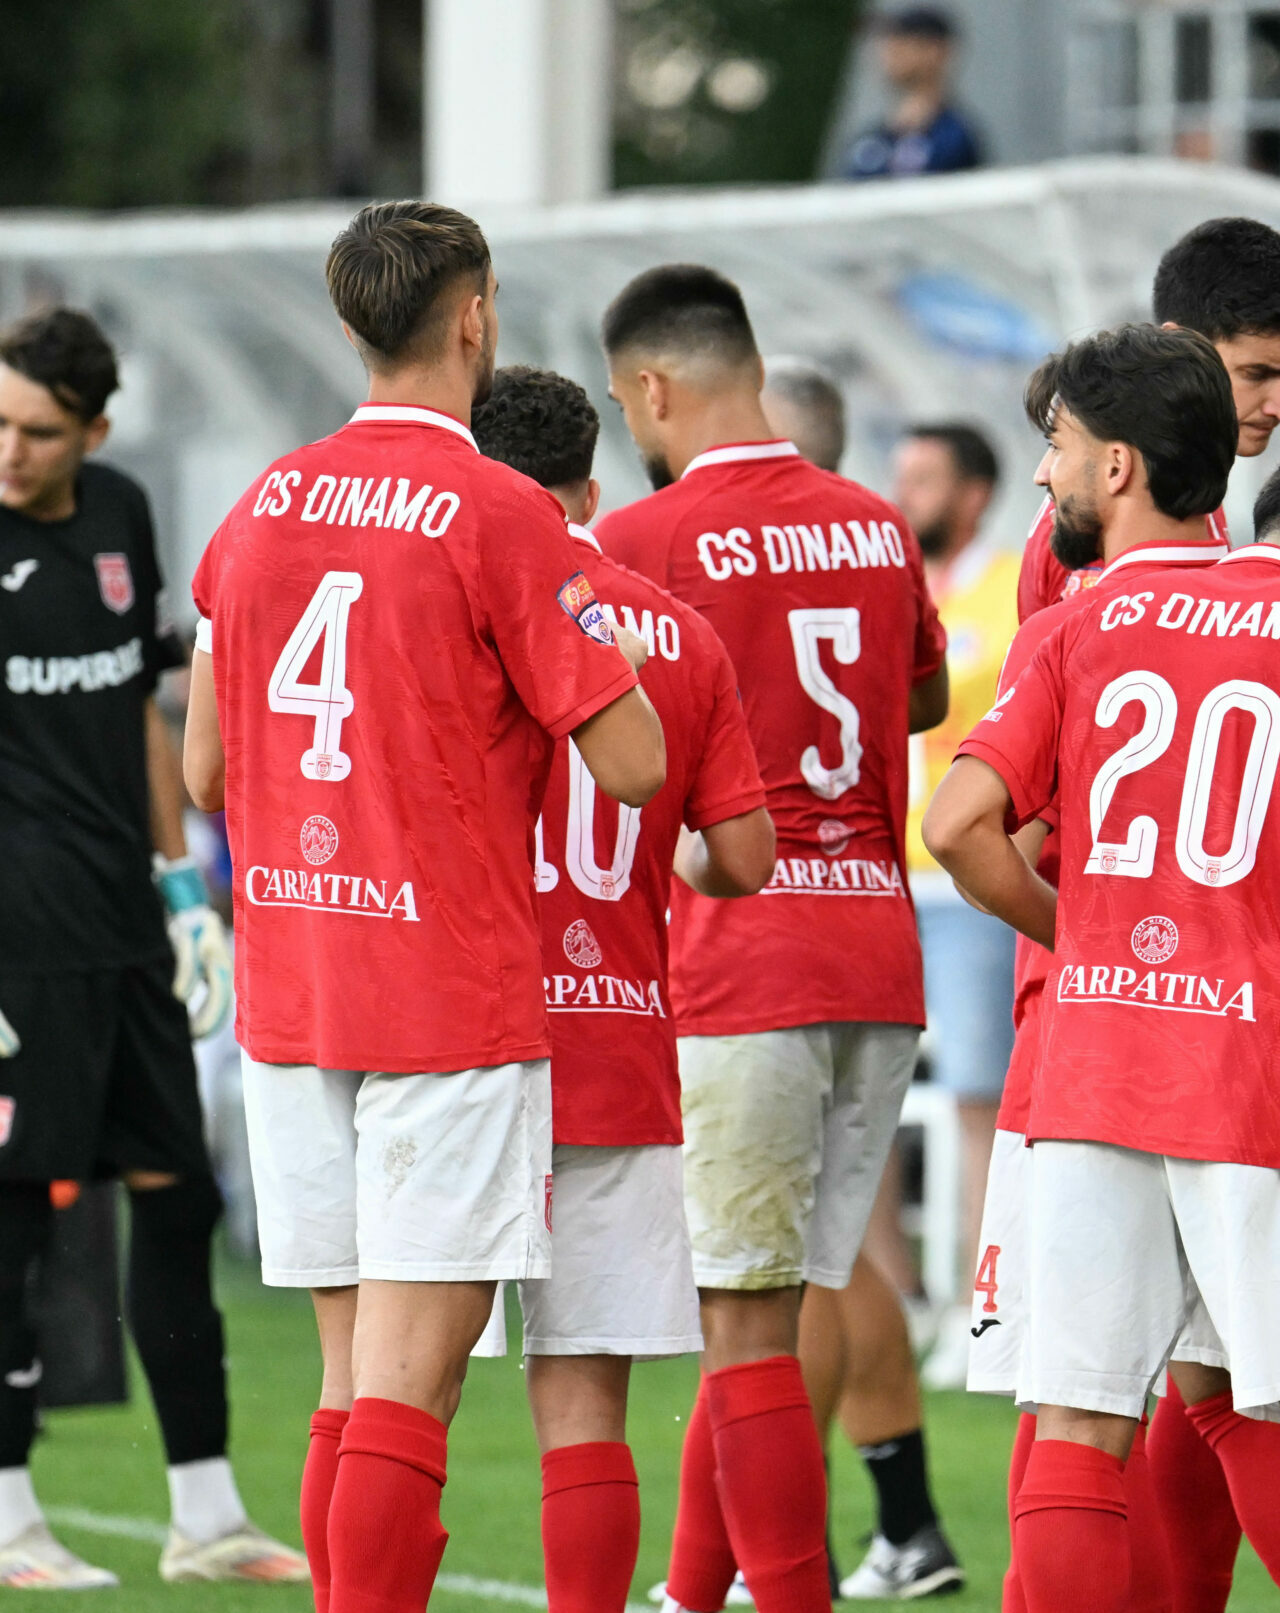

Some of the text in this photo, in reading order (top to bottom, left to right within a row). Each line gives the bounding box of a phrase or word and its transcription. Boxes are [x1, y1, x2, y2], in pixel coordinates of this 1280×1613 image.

[252, 470, 461, 538] CS DINAMO
[696, 520, 906, 581] CS DINAMO
[1100, 591, 1154, 632] CS
[267, 570, 364, 782] 4
[787, 607, 863, 800] 5
[245, 865, 421, 922] CARPATINA
[759, 856, 907, 899] ARPATINA
[1056, 964, 1258, 1023] CARPATINA
